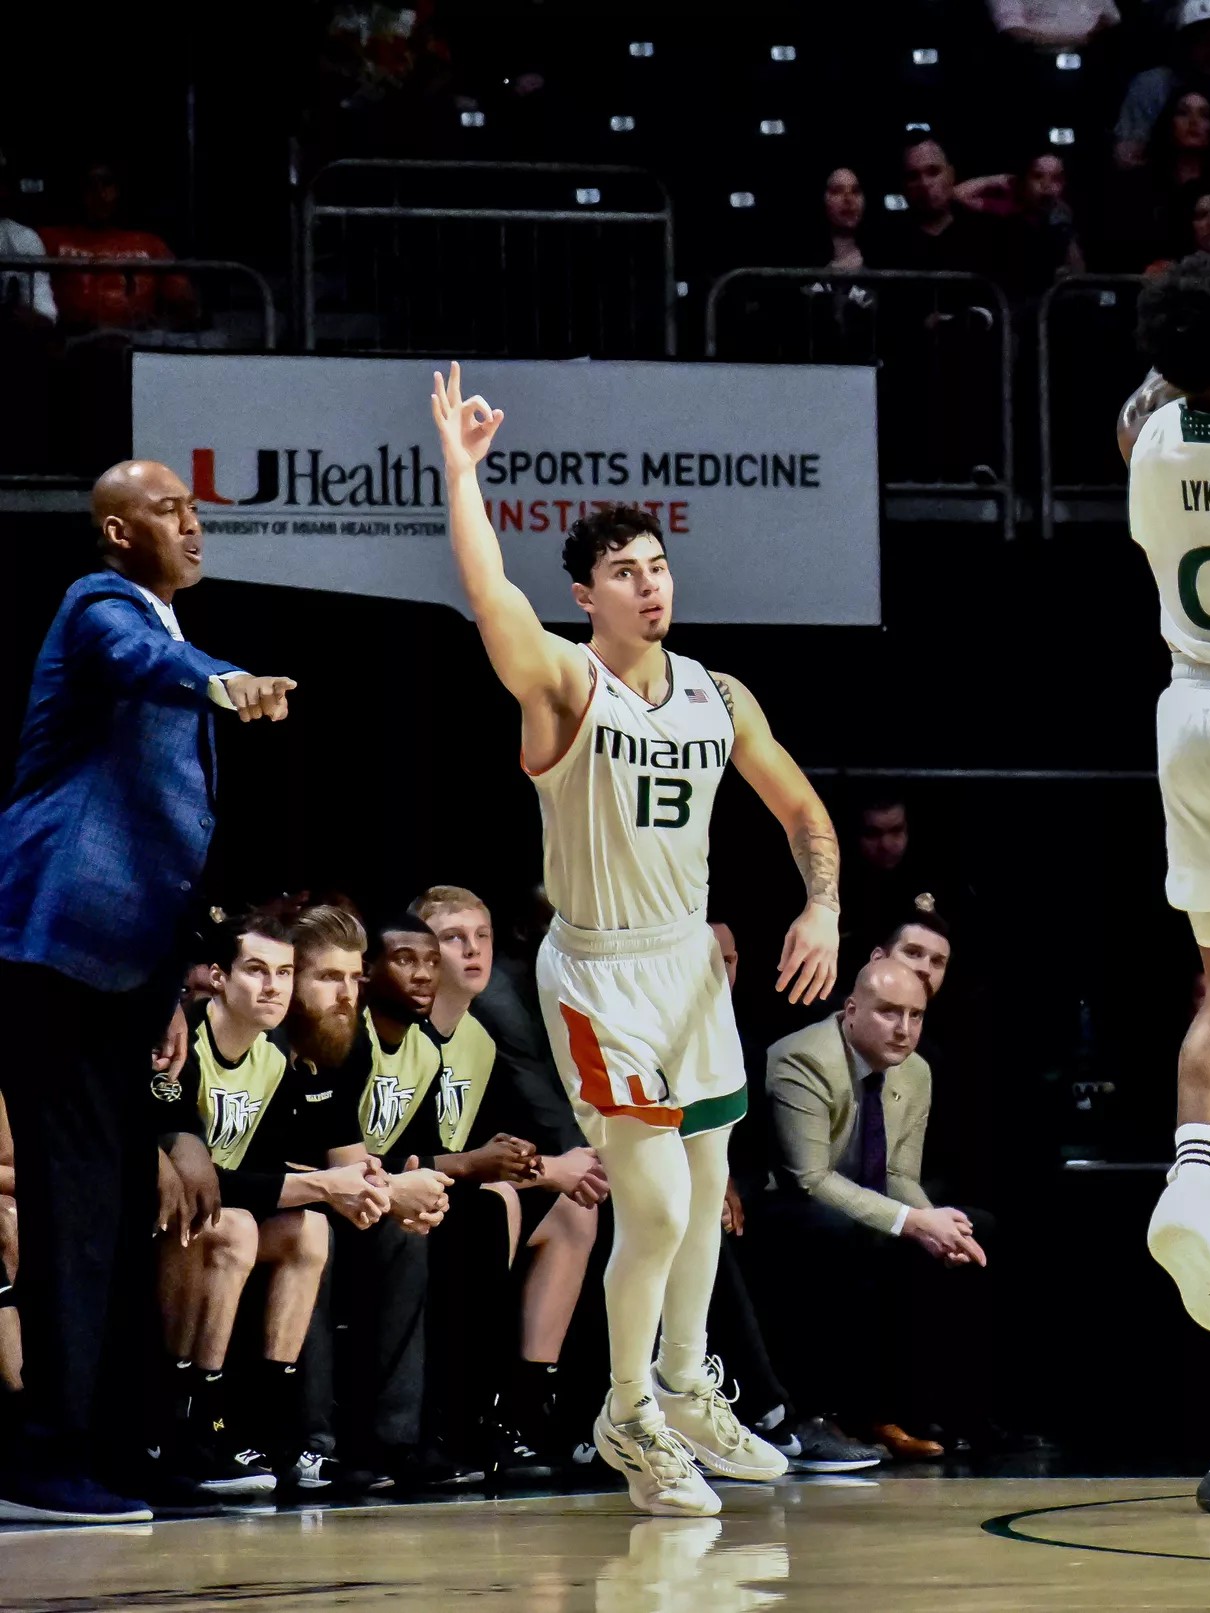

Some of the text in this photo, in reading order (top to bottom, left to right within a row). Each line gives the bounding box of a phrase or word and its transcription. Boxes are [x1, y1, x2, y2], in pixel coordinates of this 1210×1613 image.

[485, 451, 821, 488] SPORTS MEDICINE
[272, 521, 289, 535] OF
[293, 521, 337, 536] MIAMI
[341, 521, 391, 536] HEALTH
[394, 522, 446, 536] SYSTEM
[636, 775, 693, 829] 13
